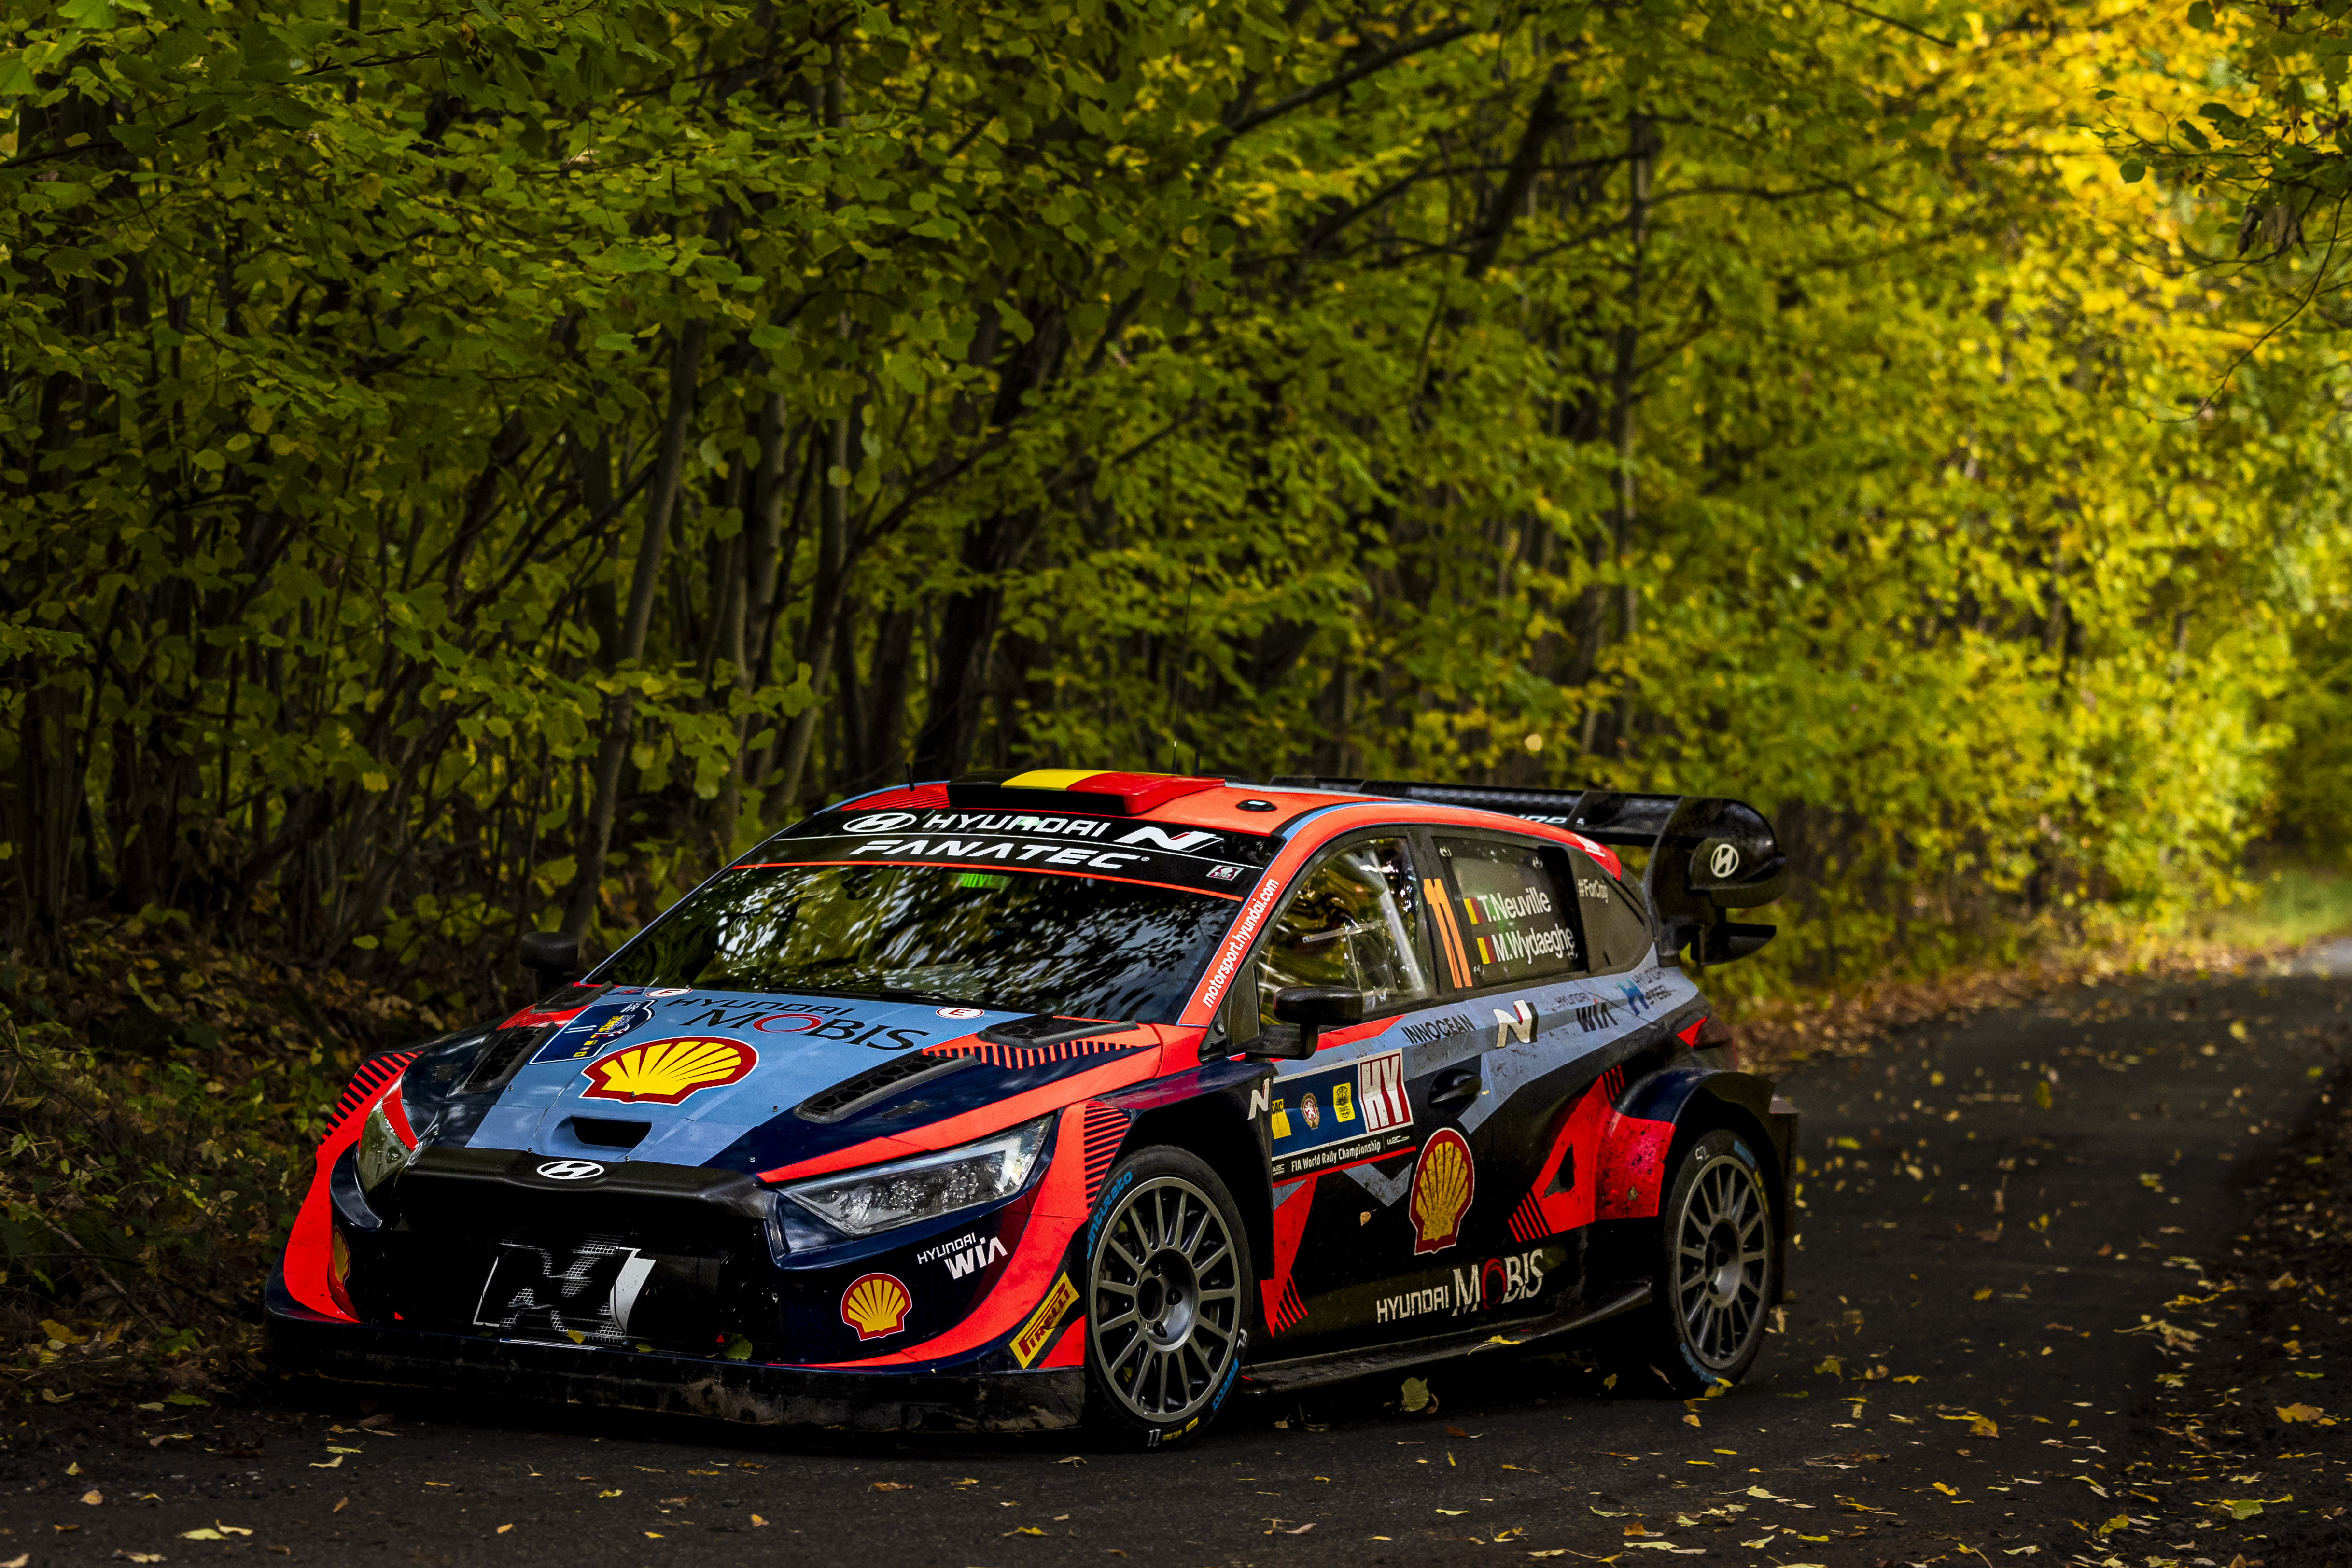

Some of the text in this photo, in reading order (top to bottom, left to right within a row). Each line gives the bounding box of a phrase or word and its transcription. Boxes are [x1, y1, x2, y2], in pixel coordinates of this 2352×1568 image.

[923, 814, 1112, 837] HYUNDAI
[849, 840, 1142, 869] FANATEC
[1477, 887, 1552, 923] T.Neuville
[1202, 878, 1279, 1008] motorsport.hyundai.com
[1423, 878, 1473, 988] 11
[1491, 924, 1576, 965] M.Wydaeghe
[665, 998, 855, 1015] HYUNDAI
[949, 1008, 973, 1017] E
[1493, 999, 1539, 1049] N
[679, 1008, 930, 1050] MOBIS
[1401, 1014, 1477, 1045] INNOCEAN
[1291, 1140, 1381, 1172] FIA World Rally Championship
[917, 1232, 976, 1265] HYUNDAI
[944, 1236, 1008, 1280] WIA
[1376, 1248, 1544, 1323] HYUNDAI MOBIS
[1018, 1282, 1070, 1358] PIRELLI
